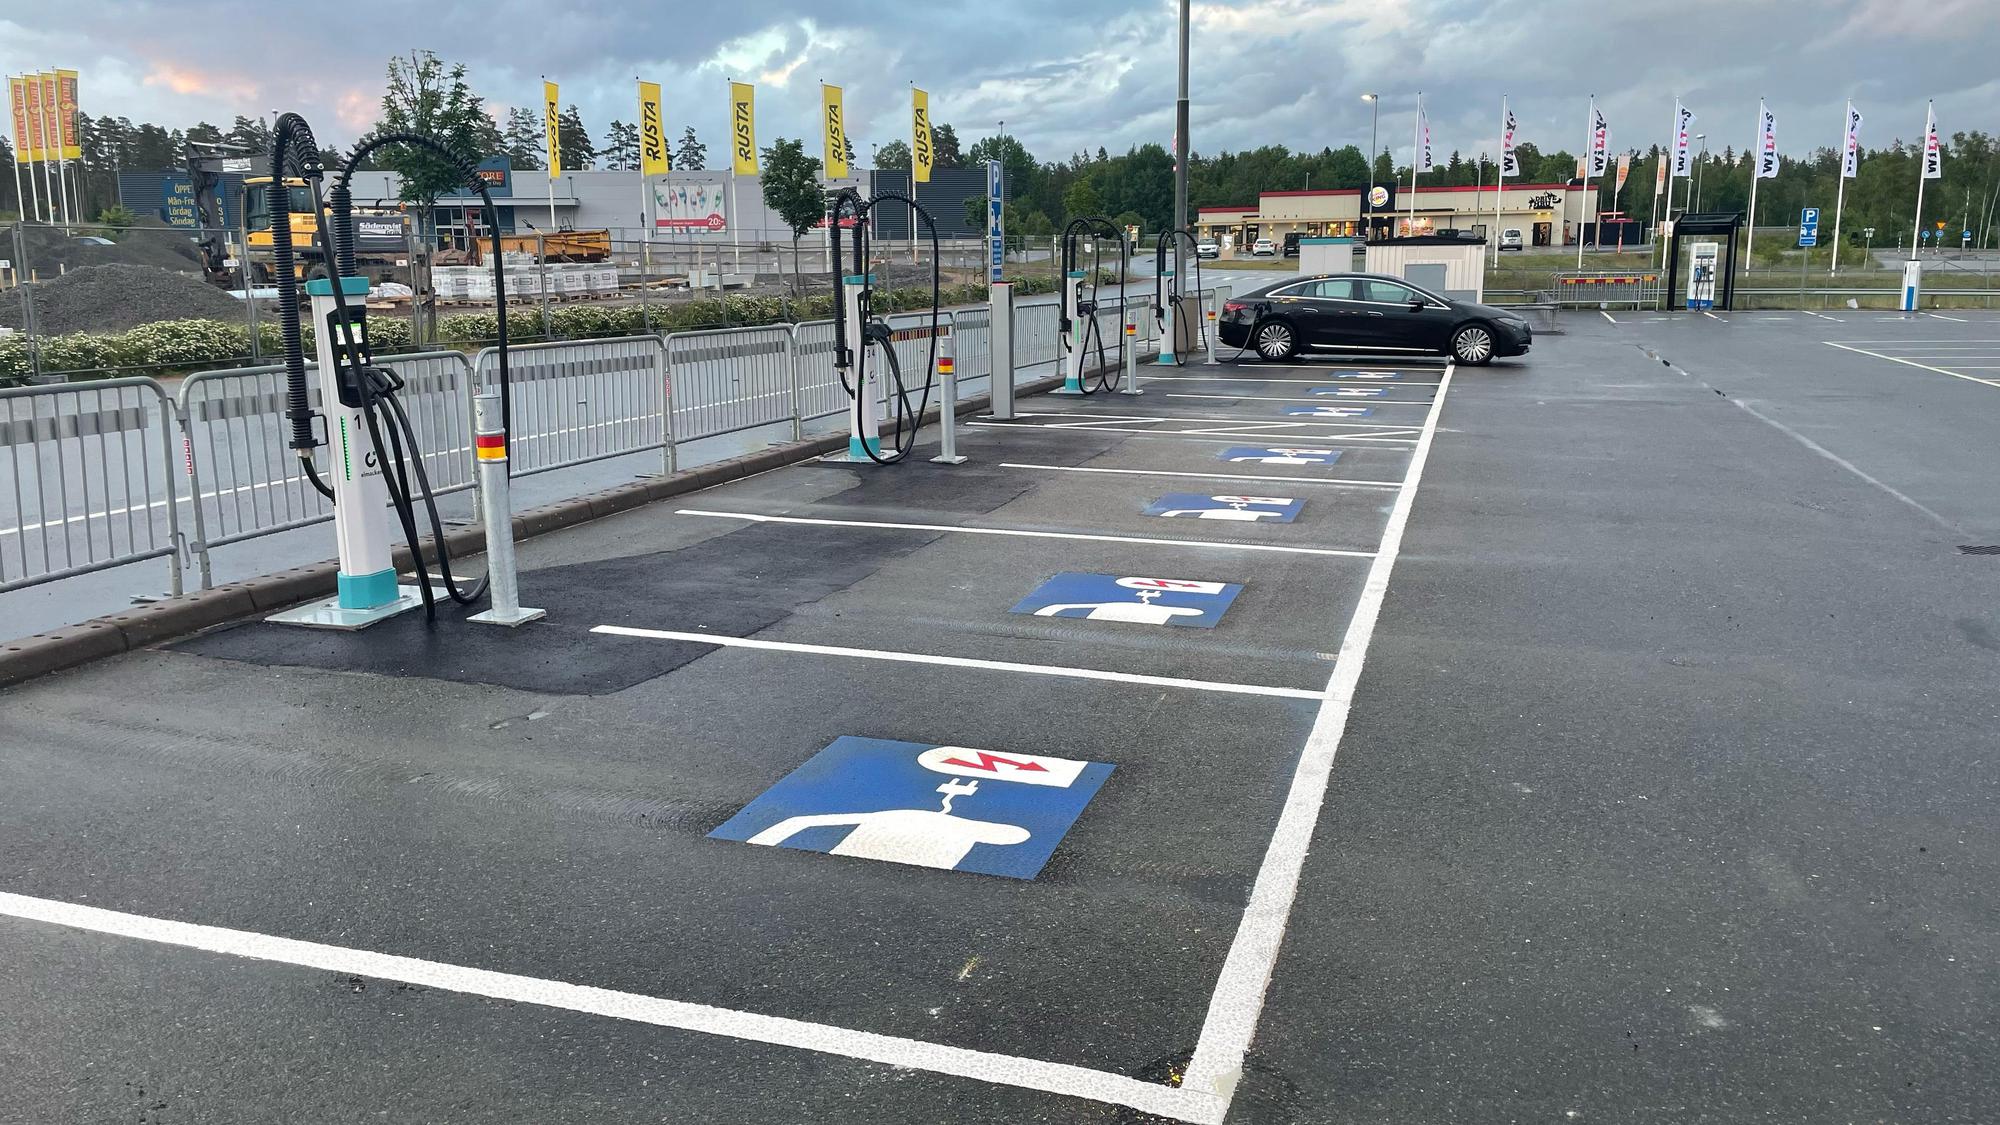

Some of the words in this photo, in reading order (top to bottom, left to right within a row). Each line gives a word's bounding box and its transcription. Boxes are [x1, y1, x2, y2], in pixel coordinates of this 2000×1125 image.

[644, 101, 661, 162] RUSTA
[736, 101, 751, 162] RUSTA
[828, 104, 844, 163] RUSTA
[915, 108, 929, 168] RUSTA
[1805, 210, 1816, 222] P
[354, 414, 361, 430] 1
